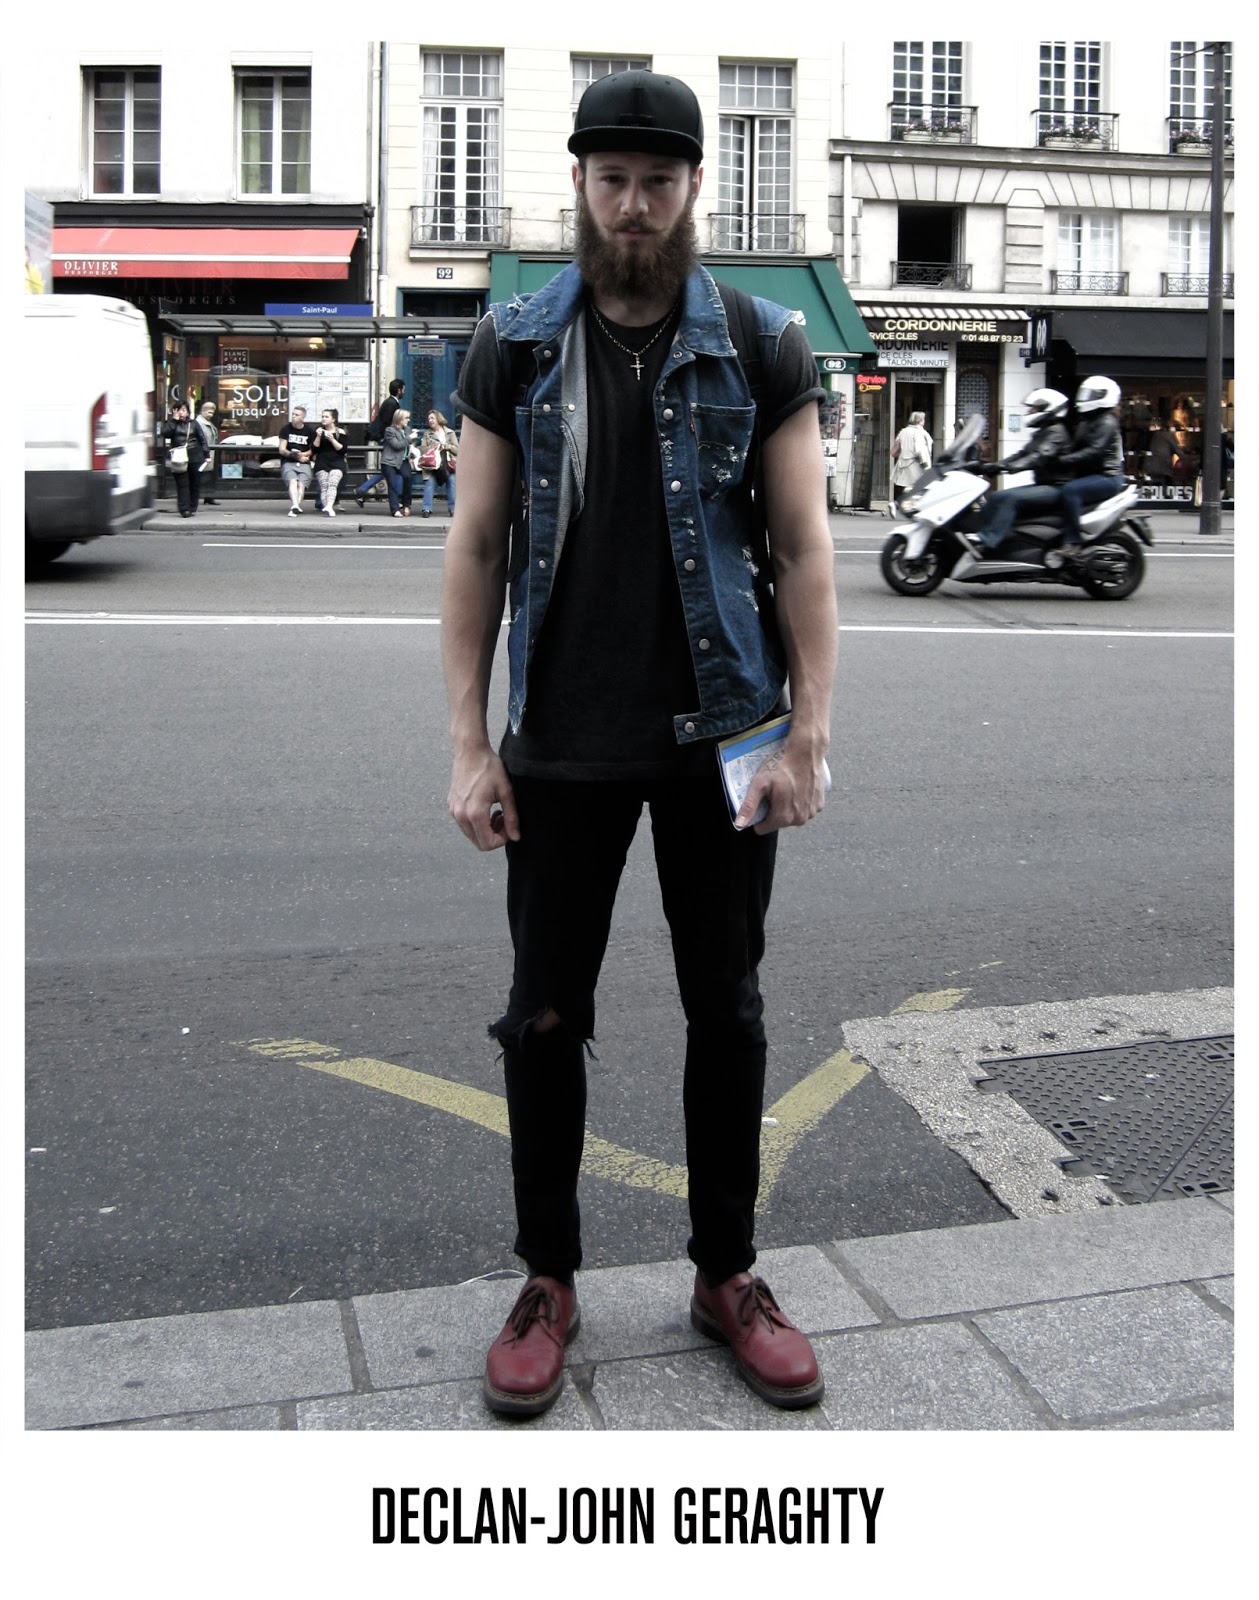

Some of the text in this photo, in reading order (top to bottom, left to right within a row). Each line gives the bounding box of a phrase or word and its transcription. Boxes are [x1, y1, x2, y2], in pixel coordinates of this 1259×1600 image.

[64, 261, 118, 271] OLIVIER
[438, 268, 452, 278] 92
[302, 306, 338, 314] Saint-Paul
[885, 319, 997, 332] CORDONNERIE
[869, 332, 918, 340] RVICE CLES
[968, 334, 977, 342] 01
[990, 335, 1000, 343] 87
[1012, 335, 1023, 343] 23
[877, 341, 949, 351] RDONNERIE
[224, 363, 245, 371] -30%
[828, 360, 842, 368] 92
[857, 374, 887, 384] Service
[233, 385, 288, 403] SOLD
[288, 434, 309, 445] GEEK
[1142, 486, 1193, 499] SOLDES
